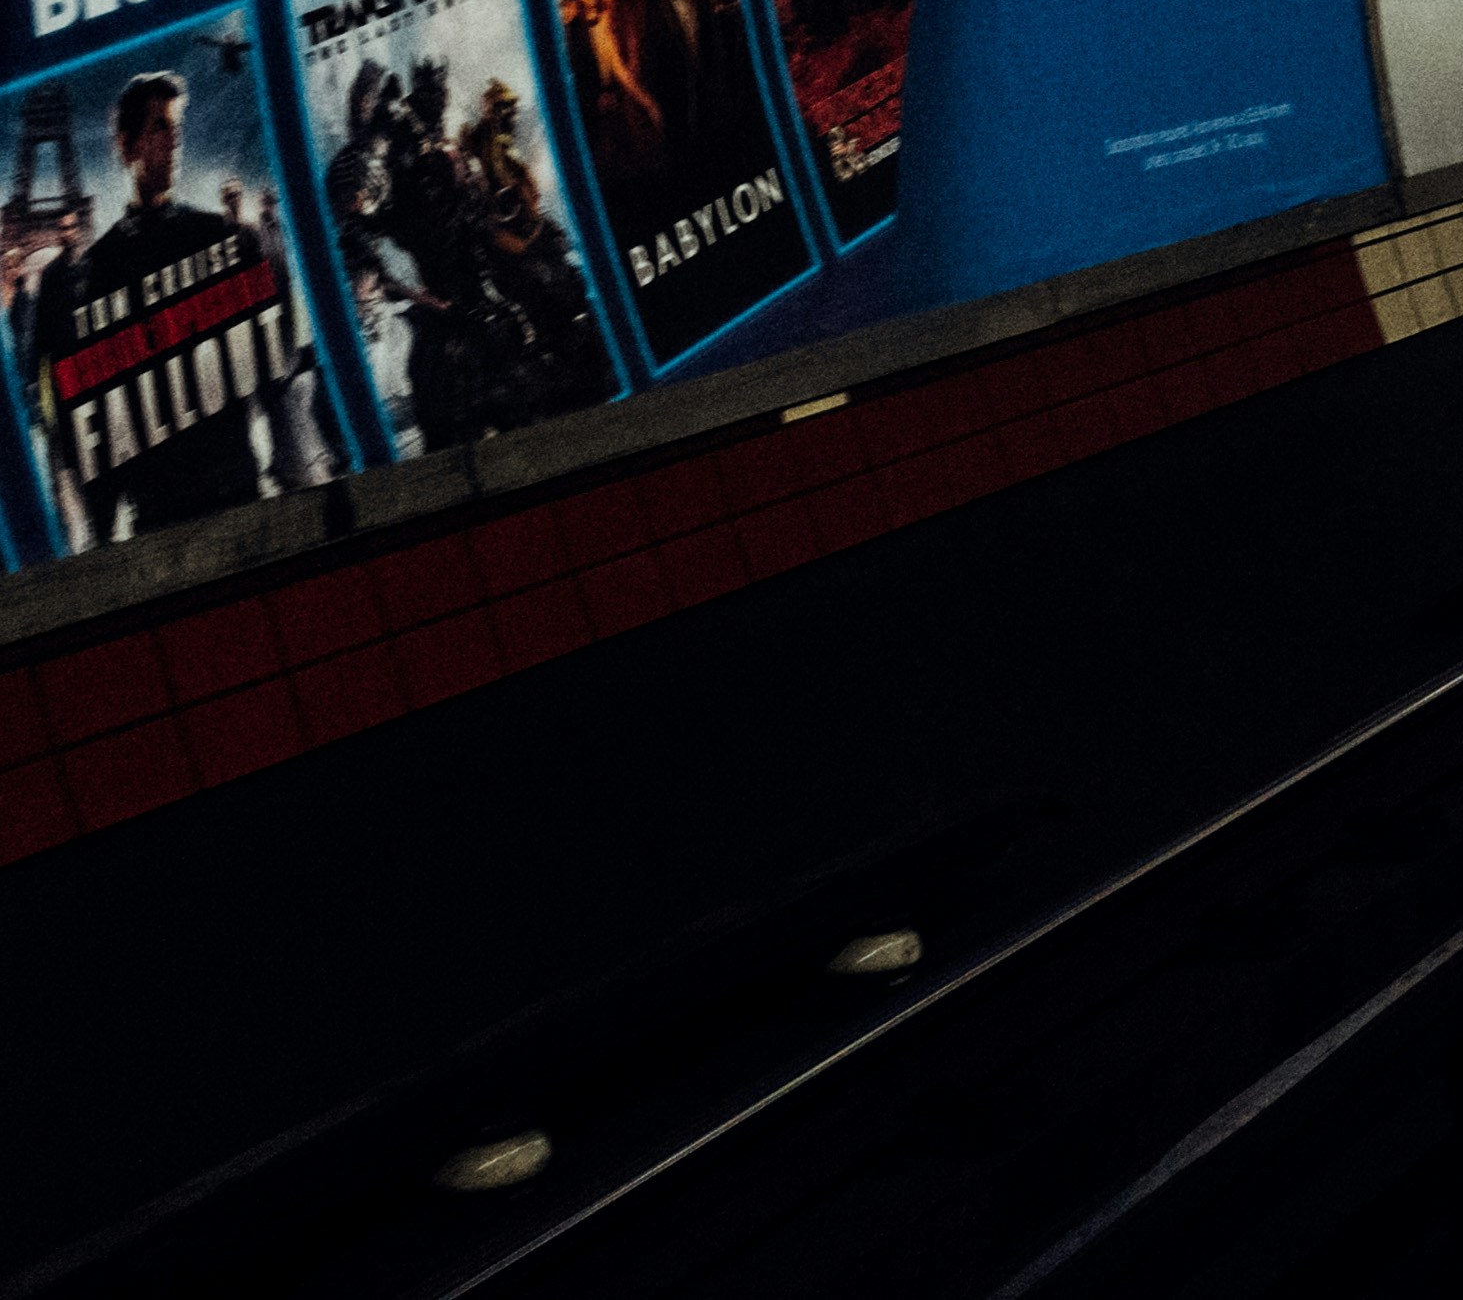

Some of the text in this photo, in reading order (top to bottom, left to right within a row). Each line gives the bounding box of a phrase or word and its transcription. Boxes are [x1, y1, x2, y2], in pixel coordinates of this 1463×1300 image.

[72, 285, 131, 341] TOM
[141, 234, 242, 308] CRUISE
[627, 166, 786, 290] BABYLON
[70, 302, 284, 486] FALLOUT
